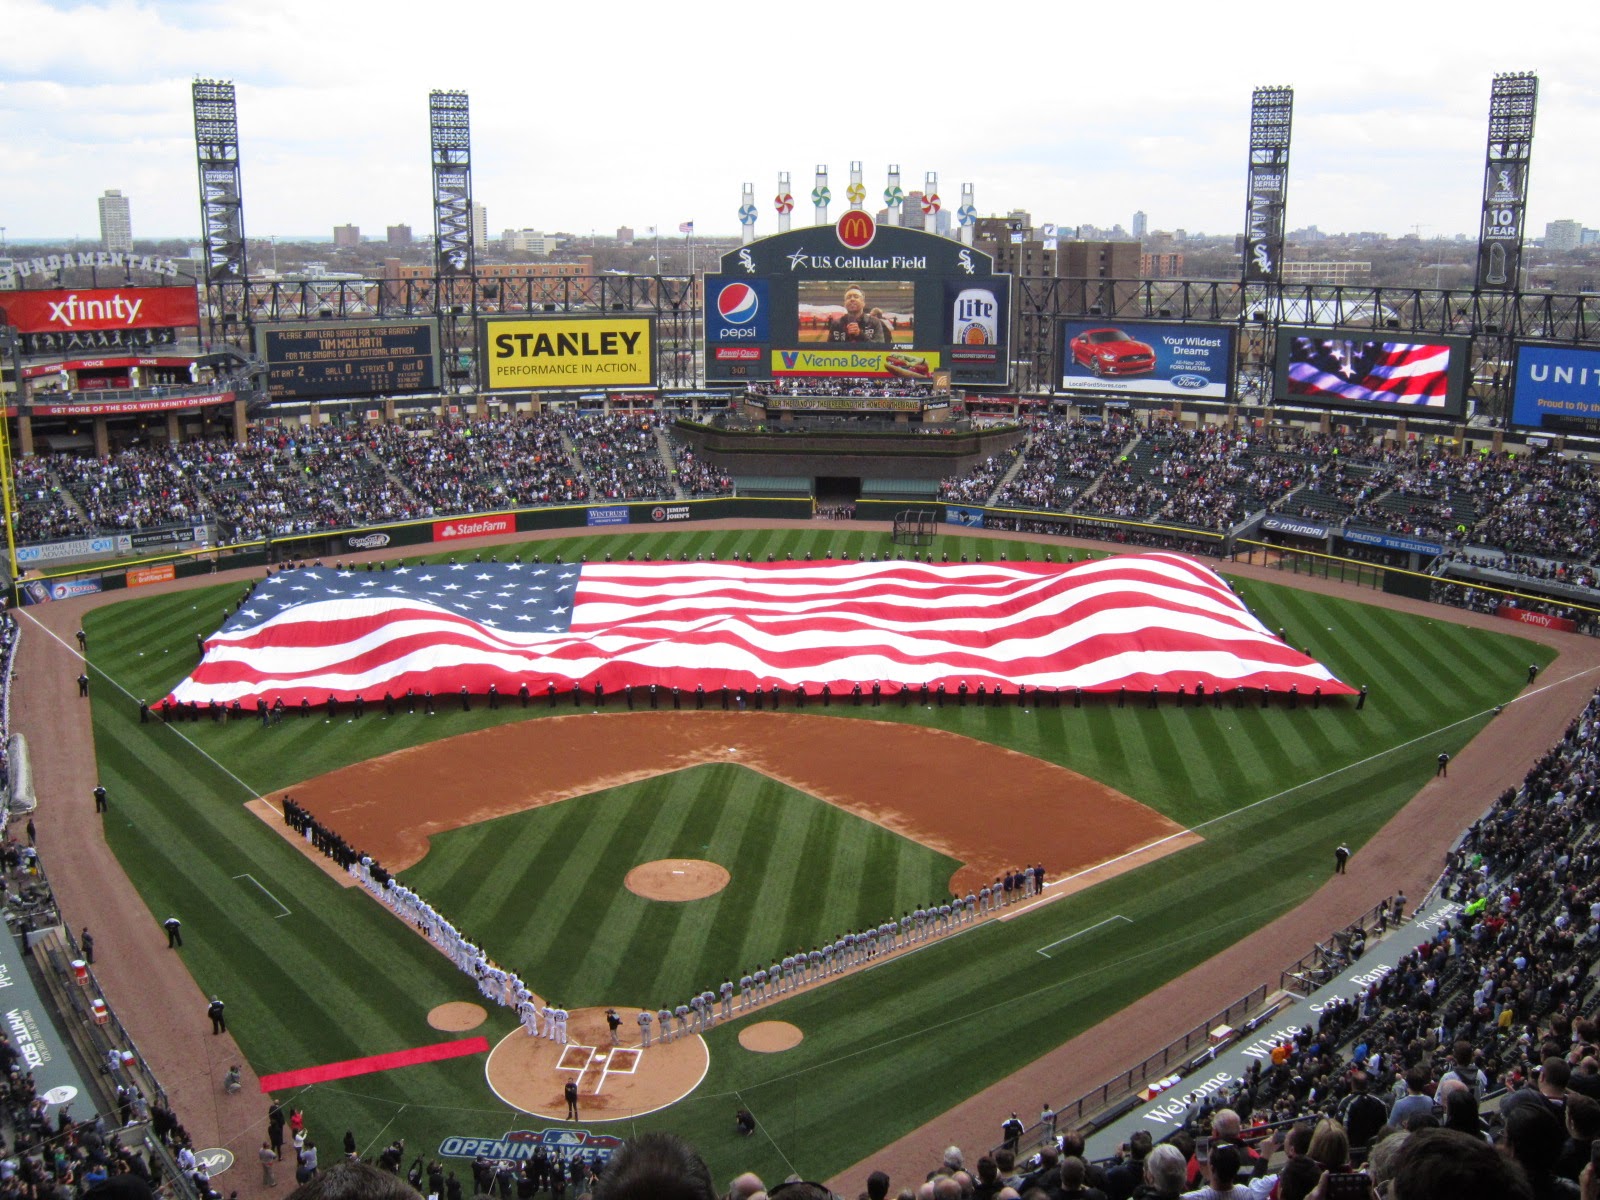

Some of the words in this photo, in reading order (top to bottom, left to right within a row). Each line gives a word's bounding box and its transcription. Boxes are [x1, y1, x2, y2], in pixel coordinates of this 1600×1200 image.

[1492, 209, 1513, 226] 10
[1487, 226, 1516, 235] YEAR
[738, 249, 756, 274] Sox
[811, 256, 833, 269] U.S.
[834, 256, 889, 269] Cellular
[892, 256, 926, 269] Field
[958, 249, 975, 274] Sox
[49, 294, 143, 327] xfinity
[958, 298, 993, 322] Lite
[278, 331, 303, 340] PLEASE
[304, 331, 318, 339] JOIN
[319, 330, 335, 338] LEAD
[336, 329, 357, 338] SINGER
[358, 329, 370, 337] FOR
[720, 326, 756, 339] pepsi
[319, 338, 336, 350] TIM
[337, 337, 383, 350] MCILRATH
[495, 331, 641, 359] STANLEY
[1162, 336, 1184, 346] Your
[1186, 337, 1221, 347] Wildest
[285, 352, 298, 360] FOR
[299, 351, 312, 360] THE
[312, 350, 337, 359] SINGING
[337, 349, 346, 358] OF
[1173, 346, 1209, 356] Dreams
[271, 370, 280, 378] AT
[298, 365, 305, 377] 2
[325, 367, 343, 375] BALL
[345, 363, 352, 374] 0
[360, 364, 385, 373] STRIKE
[387, 361, 394, 371] 0
[402, 362, 416, 371] OUT
[417, 359, 424, 370] 0
[802, 354, 848, 368] Vienna
[850, 354, 882, 371] Beef
[497, 364, 577, 376] PERFORMANCE
[581, 364, 592, 373] IN
[1177, 376, 1202, 387] Ford
[161, 400, 187, 408] XFINITY
[199, 396, 222, 404] DEMAND
[1538, 398, 1563, 409] Proud
[1565, 401, 1575, 409] to
[1577, 401, 1589, 412] fly
[1590, 403, 1600, 412] th
[667, 506, 690, 514] JIMMY
[667, 513, 690, 521] JOHN'S
[1280, 522, 1323, 537] HYUNDAI
[1345, 531, 1382, 544] ATHLETICO
[69, 541, 89, 549] FIELD
[43, 548, 89, 559] ADVANTAGE
[70, 585, 97, 593] TOTAL
[1521, 612, 1551, 627] xfinity
[6, 1008, 31, 1044] WHITE
[20, 1042, 44, 1070] SOX
[1143, 1071, 1233, 1124] Welcome
[1241, 1024, 1302, 1059] White
[1349, 964, 1392, 987] Fans
[444, 1138, 553, 1160] OPENIN
[560, 1146, 618, 1164] WEE
